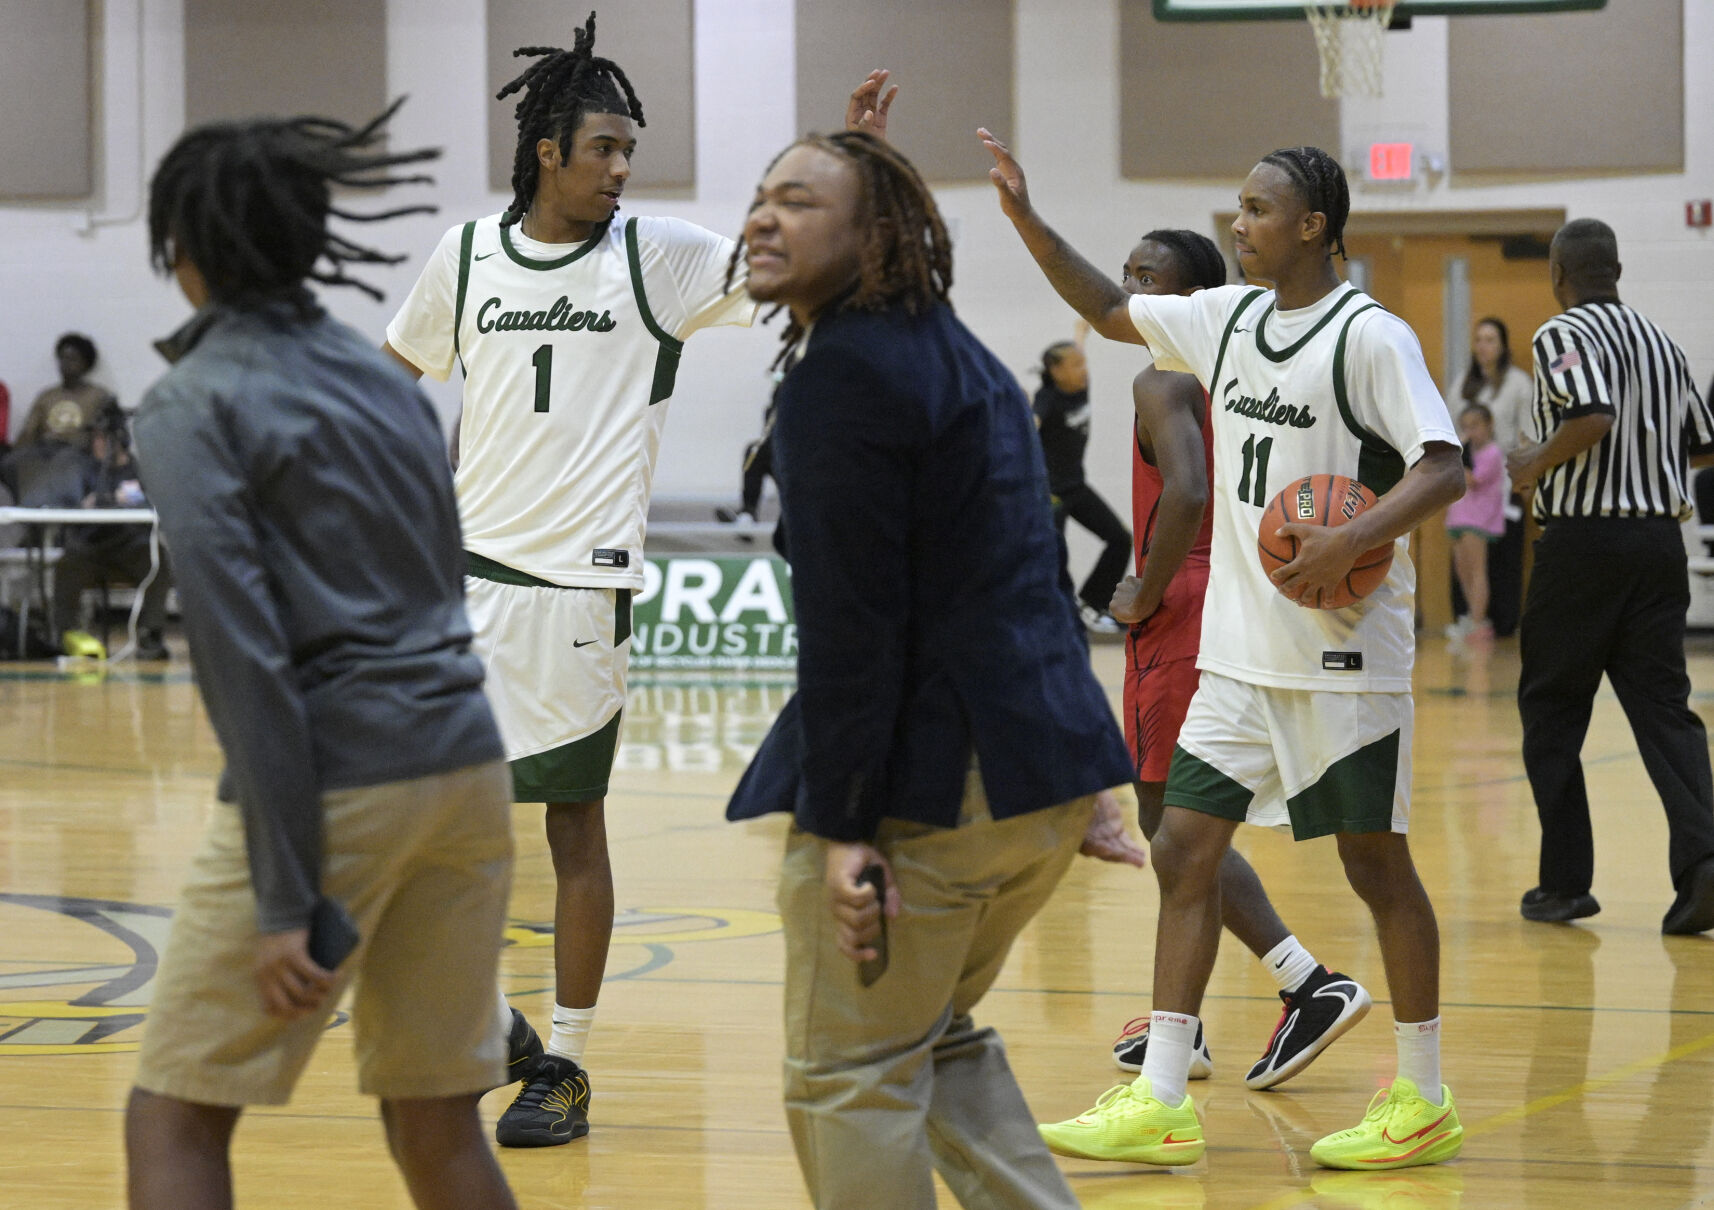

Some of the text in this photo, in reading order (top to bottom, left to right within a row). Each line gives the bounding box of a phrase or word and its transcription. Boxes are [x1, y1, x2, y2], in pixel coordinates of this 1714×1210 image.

[476, 295, 617, 335] Cavaliers
[532, 344, 553, 413] 1
[1238, 433, 1273, 508] 11
[1300, 493, 1313, 516] PRO
[631, 622, 799, 656] NDUSTR
